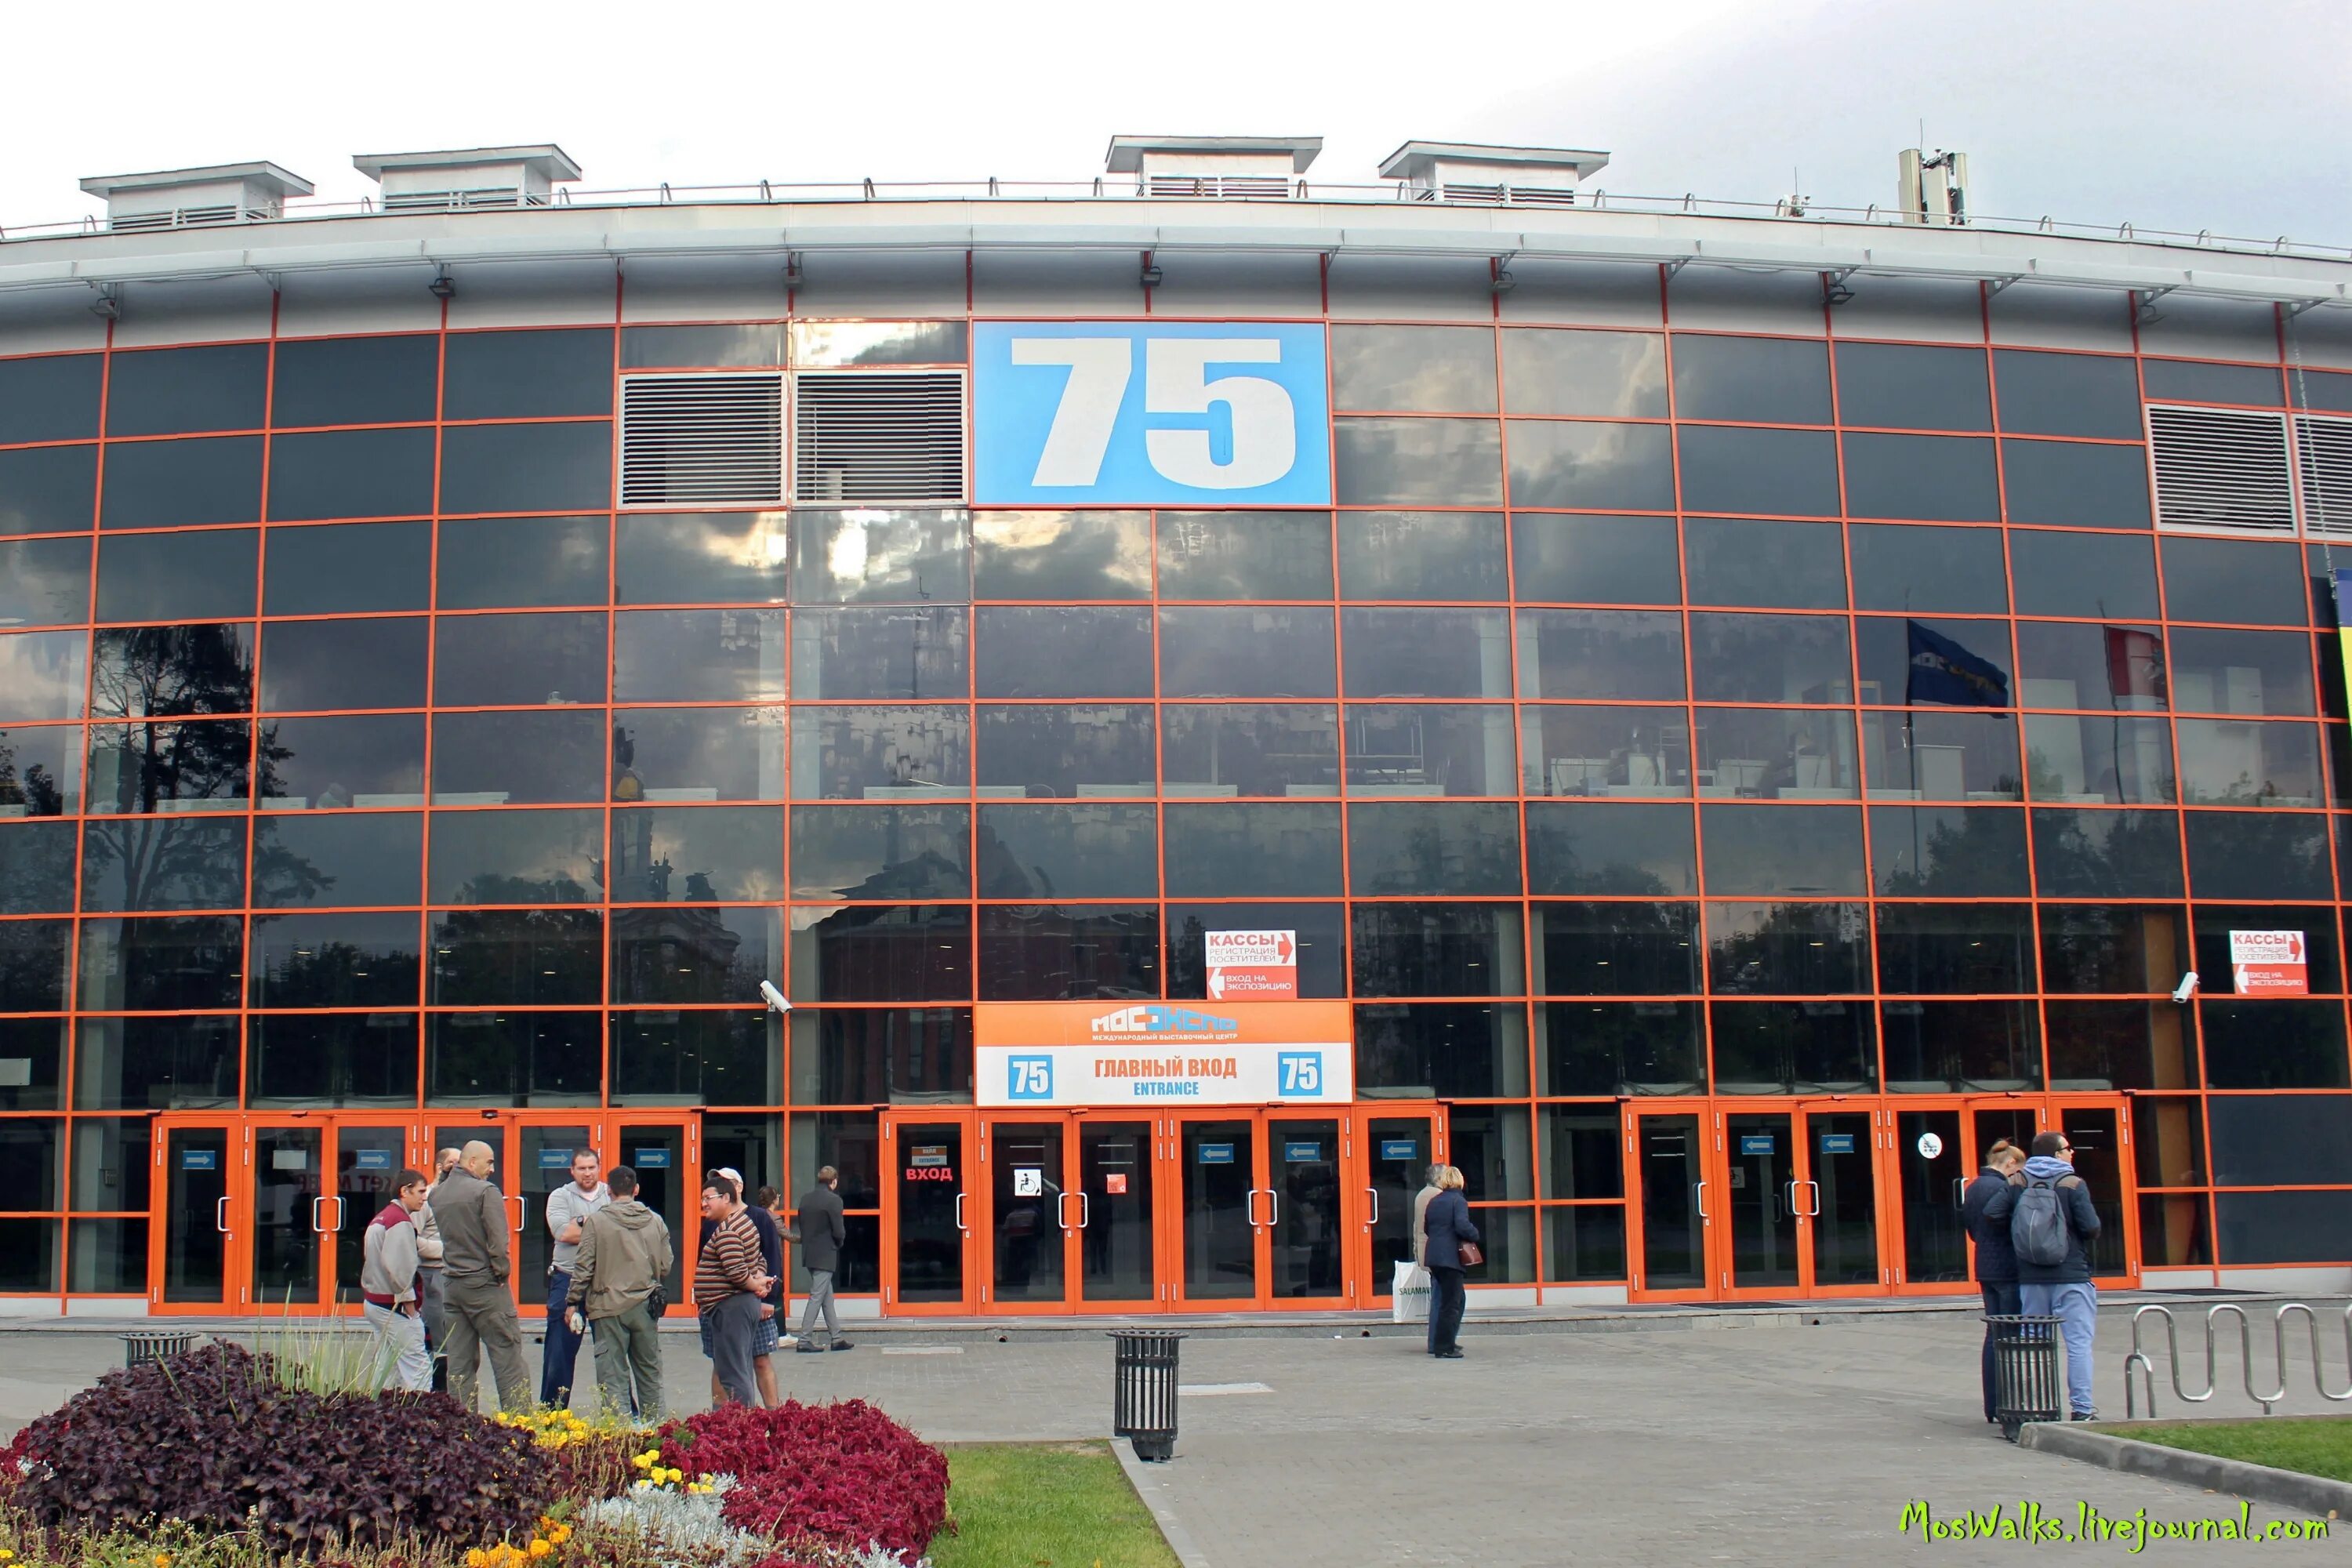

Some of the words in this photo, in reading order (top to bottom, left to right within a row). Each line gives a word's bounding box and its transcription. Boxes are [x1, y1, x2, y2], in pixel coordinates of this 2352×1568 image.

[1011, 338, 1296, 489] 75
[1210, 935, 1275, 946] КАССЫ
[2234, 935, 2287, 945] КАССЫ
[1226, 975, 1251, 983] ВХОД
[1227, 982, 1292, 991] ЭКСПОЗИЦИЮ
[1095, 1055, 1182, 1077] ГЛАВНЫЙ
[1189, 1058, 1236, 1079] ВХОД
[1012, 1062, 1049, 1094] 75
[1282, 1058, 1318, 1090] 75
[1134, 1082, 1199, 1095] ENTRANCE
[906, 1168, 953, 1181] ВХОД
